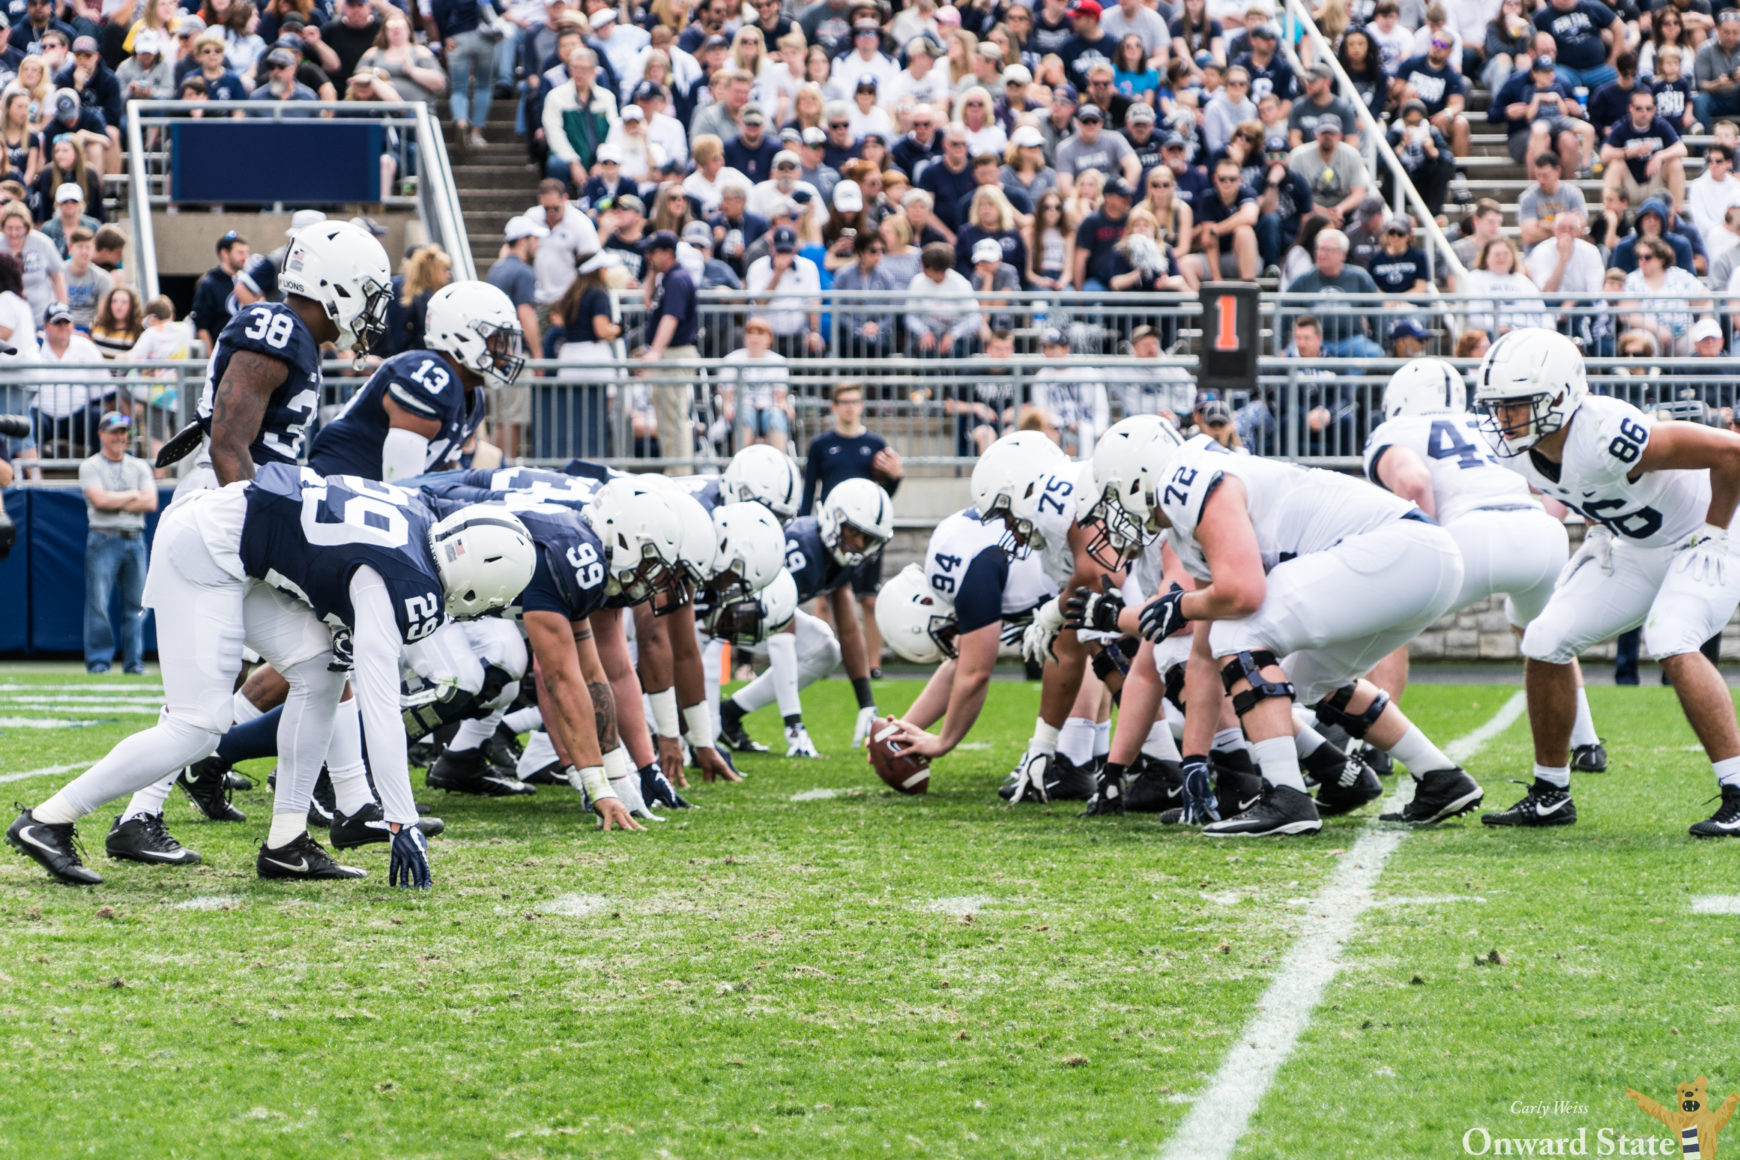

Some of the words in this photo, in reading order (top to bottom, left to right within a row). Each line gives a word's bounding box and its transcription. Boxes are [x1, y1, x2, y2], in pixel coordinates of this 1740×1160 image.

[283, 280, 305, 292] LIONS
[245, 307, 294, 349] 38
[1215, 294, 1240, 351] 1
[410, 359, 450, 395] 13
[1609, 417, 1648, 463] 86
[1038, 475, 1074, 515] 75
[1164, 465, 1199, 506] 72
[566, 542, 604, 590] 99
[931, 552, 962, 594] 94
[404, 592, 439, 641] 29
[1338, 760, 1362, 788] NIKE
